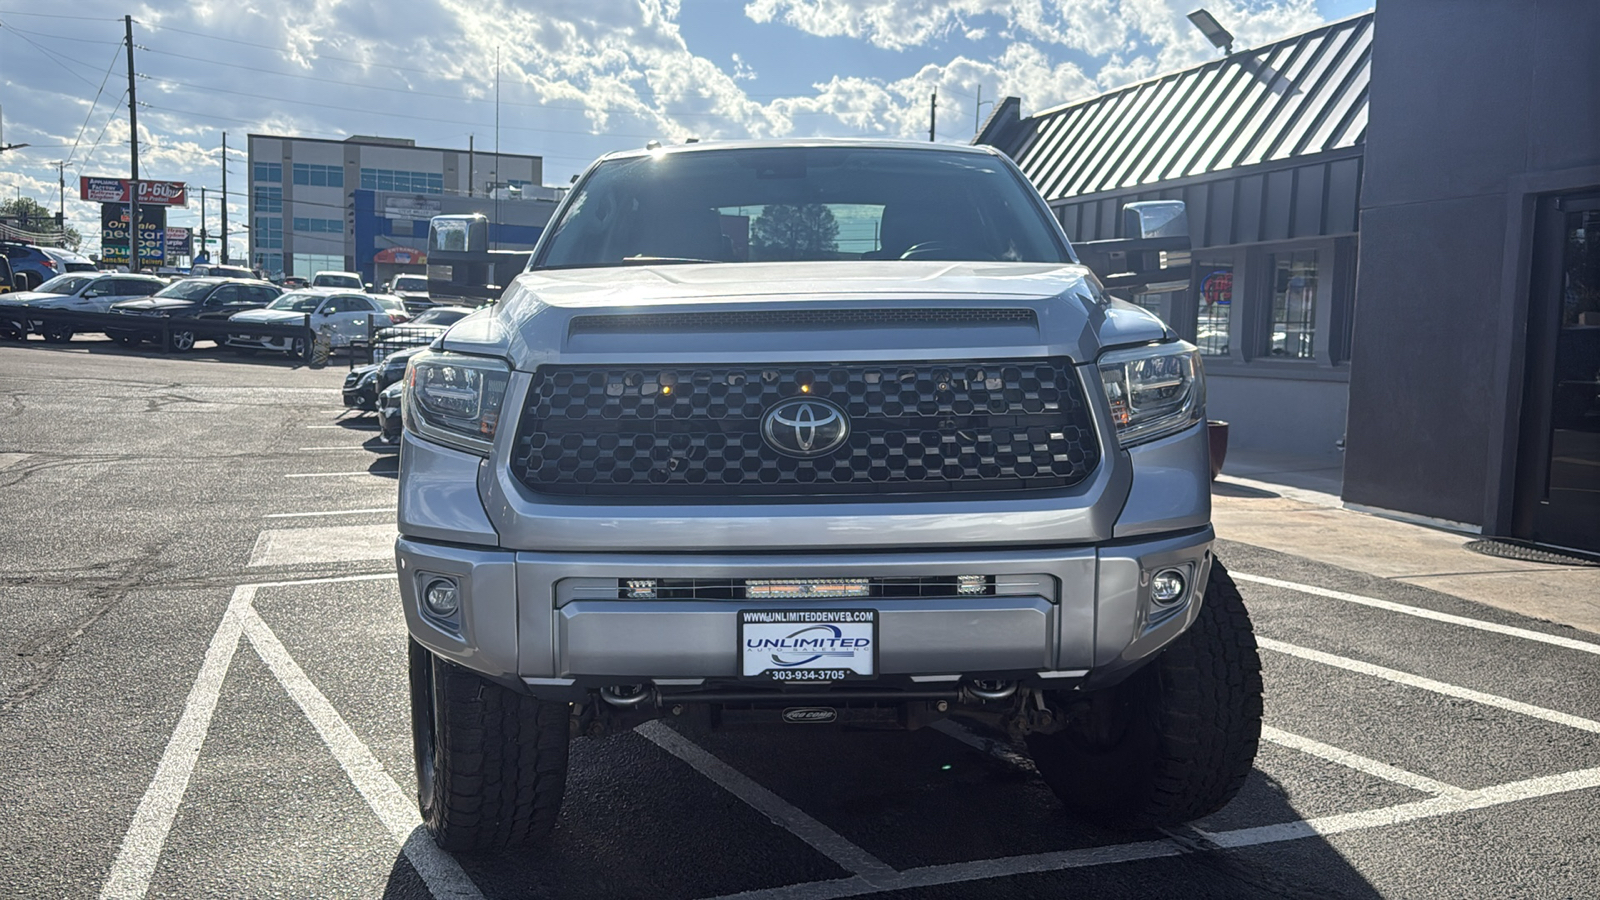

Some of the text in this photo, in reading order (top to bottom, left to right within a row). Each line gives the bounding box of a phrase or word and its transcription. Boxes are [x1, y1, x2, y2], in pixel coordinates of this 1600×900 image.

[108, 220, 156, 230] On ale
[743, 611, 873, 622] WWW.UNLIMITEDDENVER.COM
[746, 638, 870, 648] UNLIMITED
[772, 670, 845, 680] 303-934-3705
